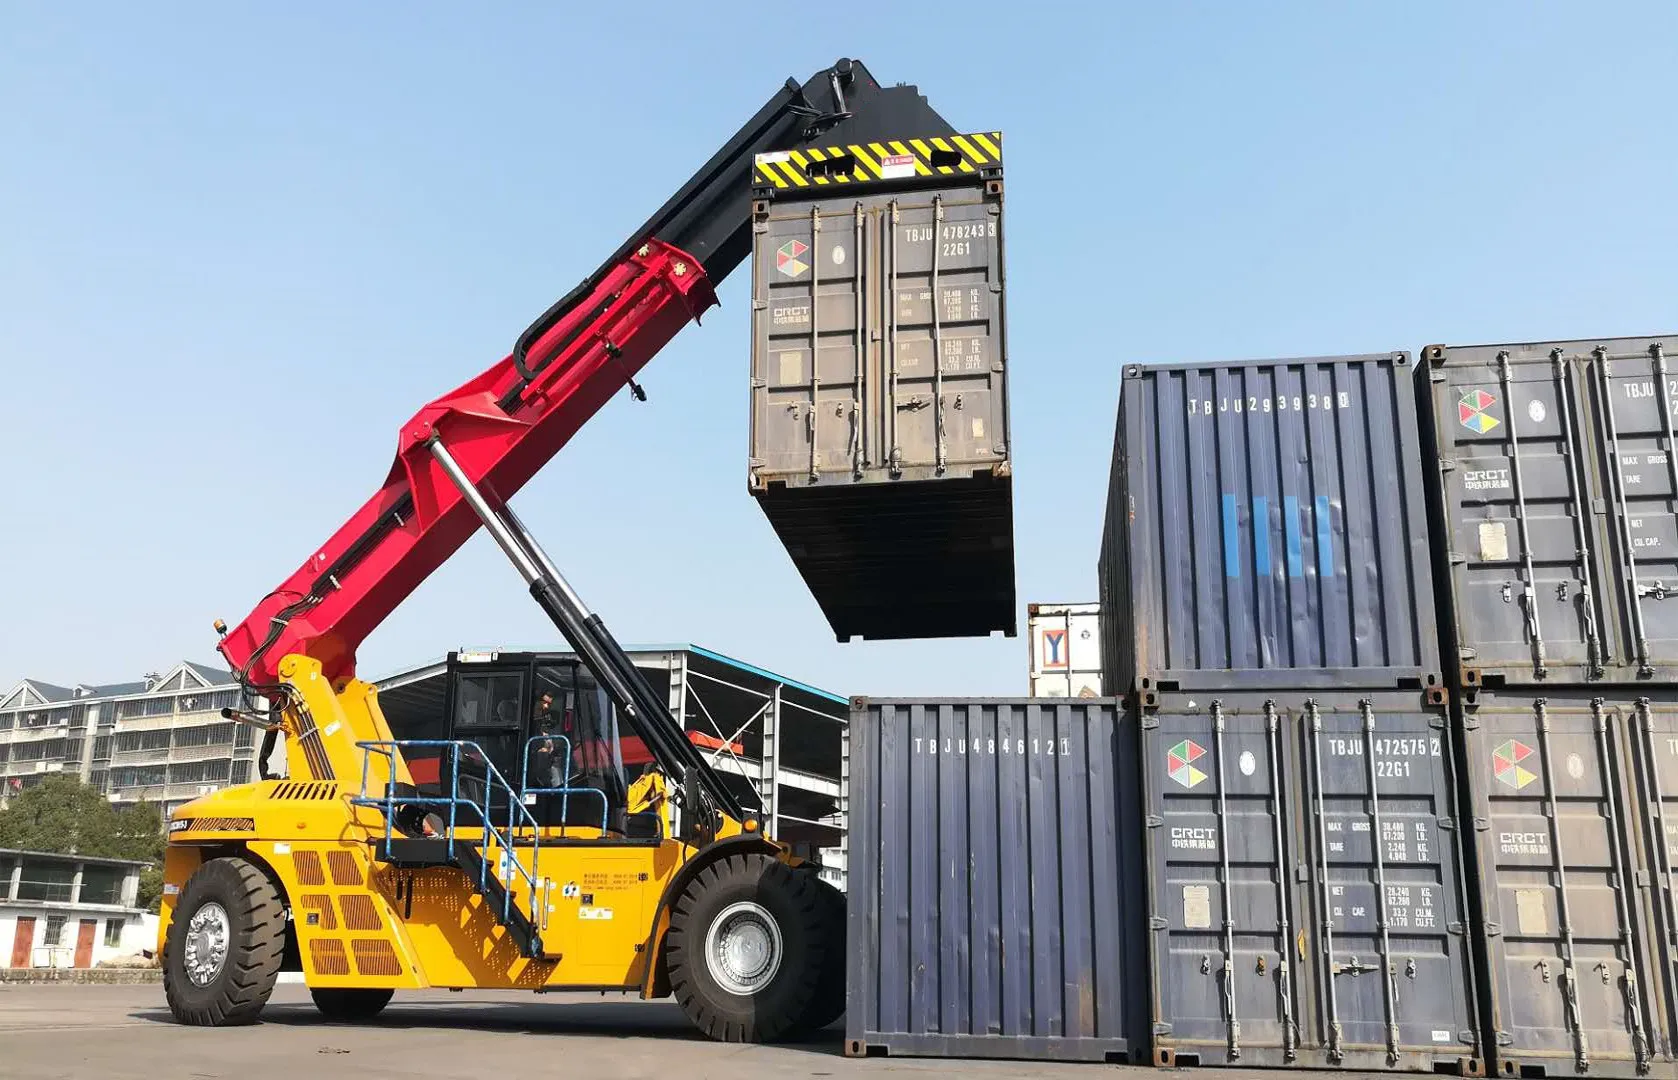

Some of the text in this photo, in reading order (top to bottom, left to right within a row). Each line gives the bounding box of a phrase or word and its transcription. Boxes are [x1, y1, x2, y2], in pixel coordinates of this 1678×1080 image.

[905, 227, 933, 242] TBJU
[943, 224, 984, 240] 478243
[943, 241, 970, 256] 22G1
[1623, 381, 1654, 398] TBJU
[1623, 455, 1667, 465] MAX GROSS
[1632, 519, 1643, 528] NET
[1329, 739, 1363, 755] TBJU
[1375, 739, 1426, 755] 472575
[1377, 761, 1410, 777] 22G1
[1171, 827, 1215, 839] CRCT
[1327, 822, 1342, 832] MAX
[1352, 822, 1371, 832] GROSS
[1500, 832, 1547, 844] CRCT
[1332, 886, 1344, 896] NET
